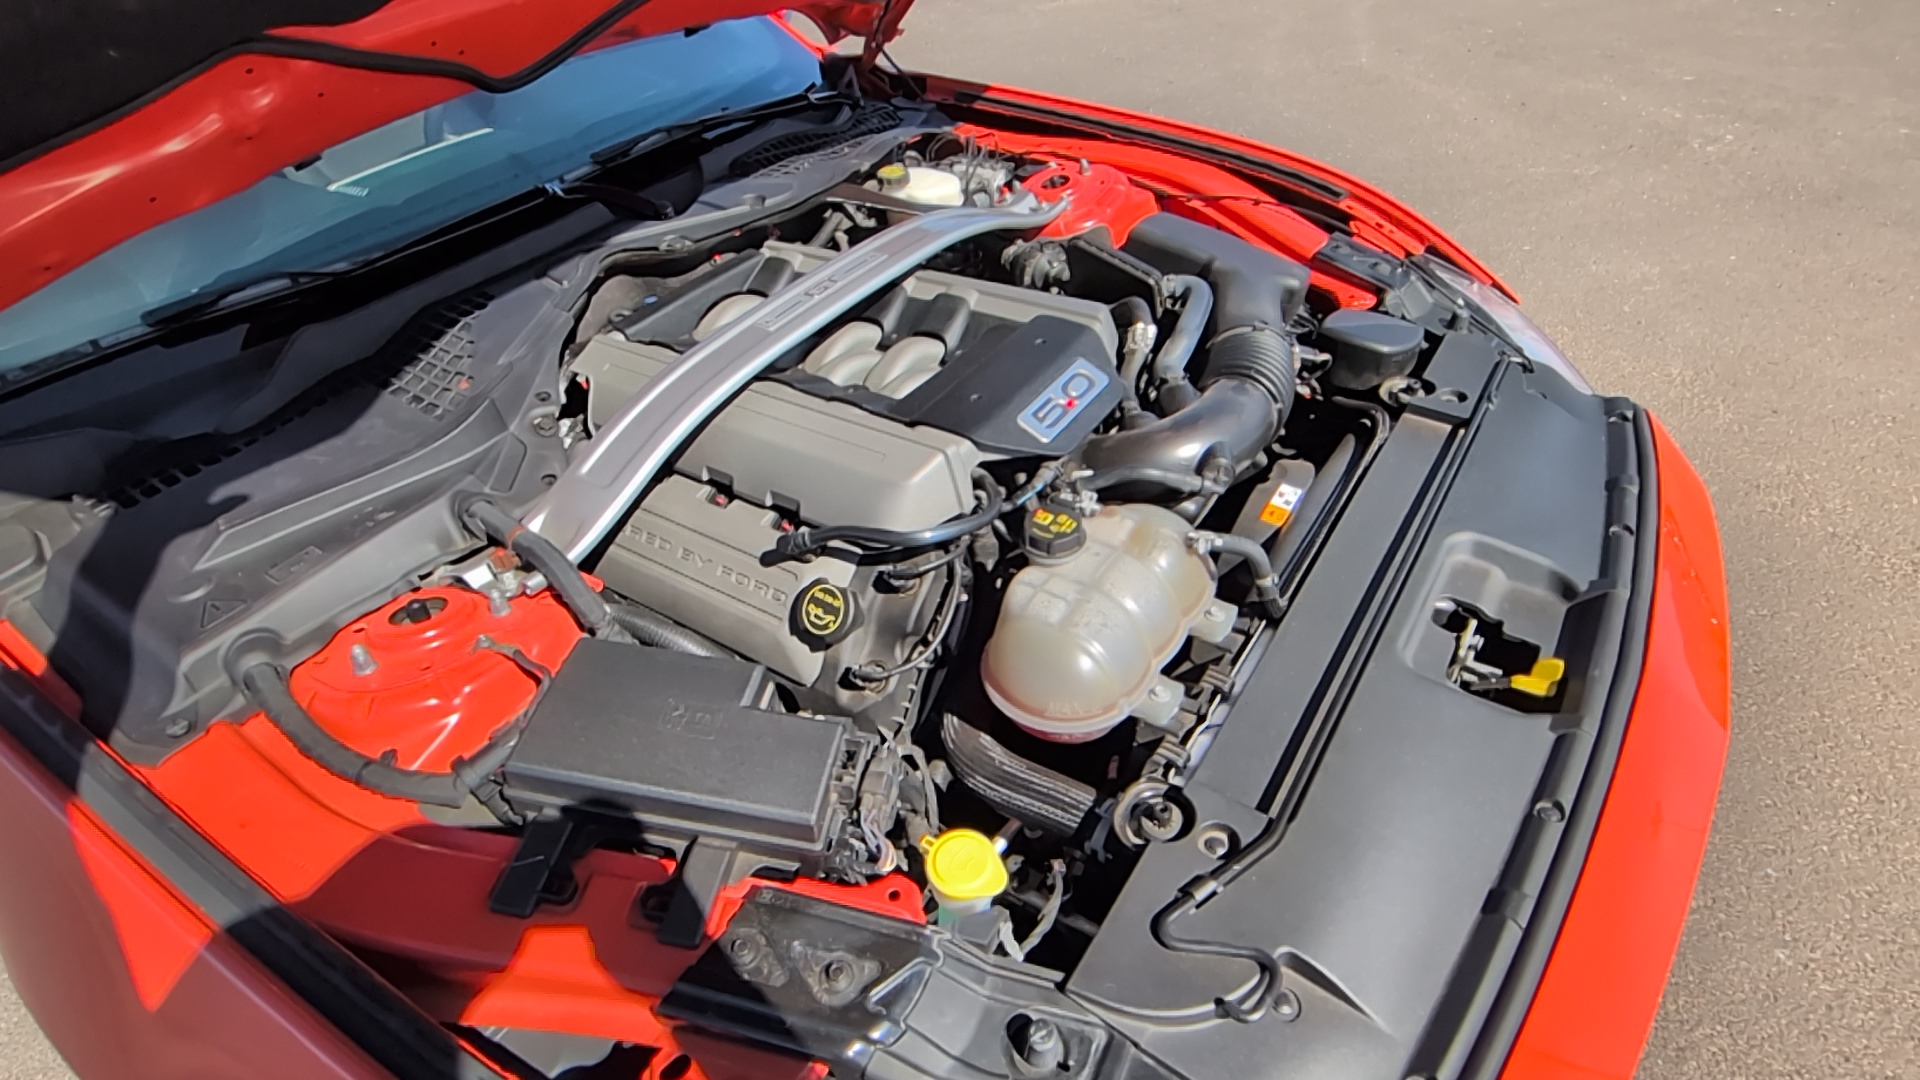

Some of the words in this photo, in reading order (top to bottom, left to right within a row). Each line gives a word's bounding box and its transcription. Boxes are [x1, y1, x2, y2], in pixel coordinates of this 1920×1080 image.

[1031, 367, 1097, 430] 5.0
[677, 546, 713, 569] BY
[716, 564, 789, 603] FORD
